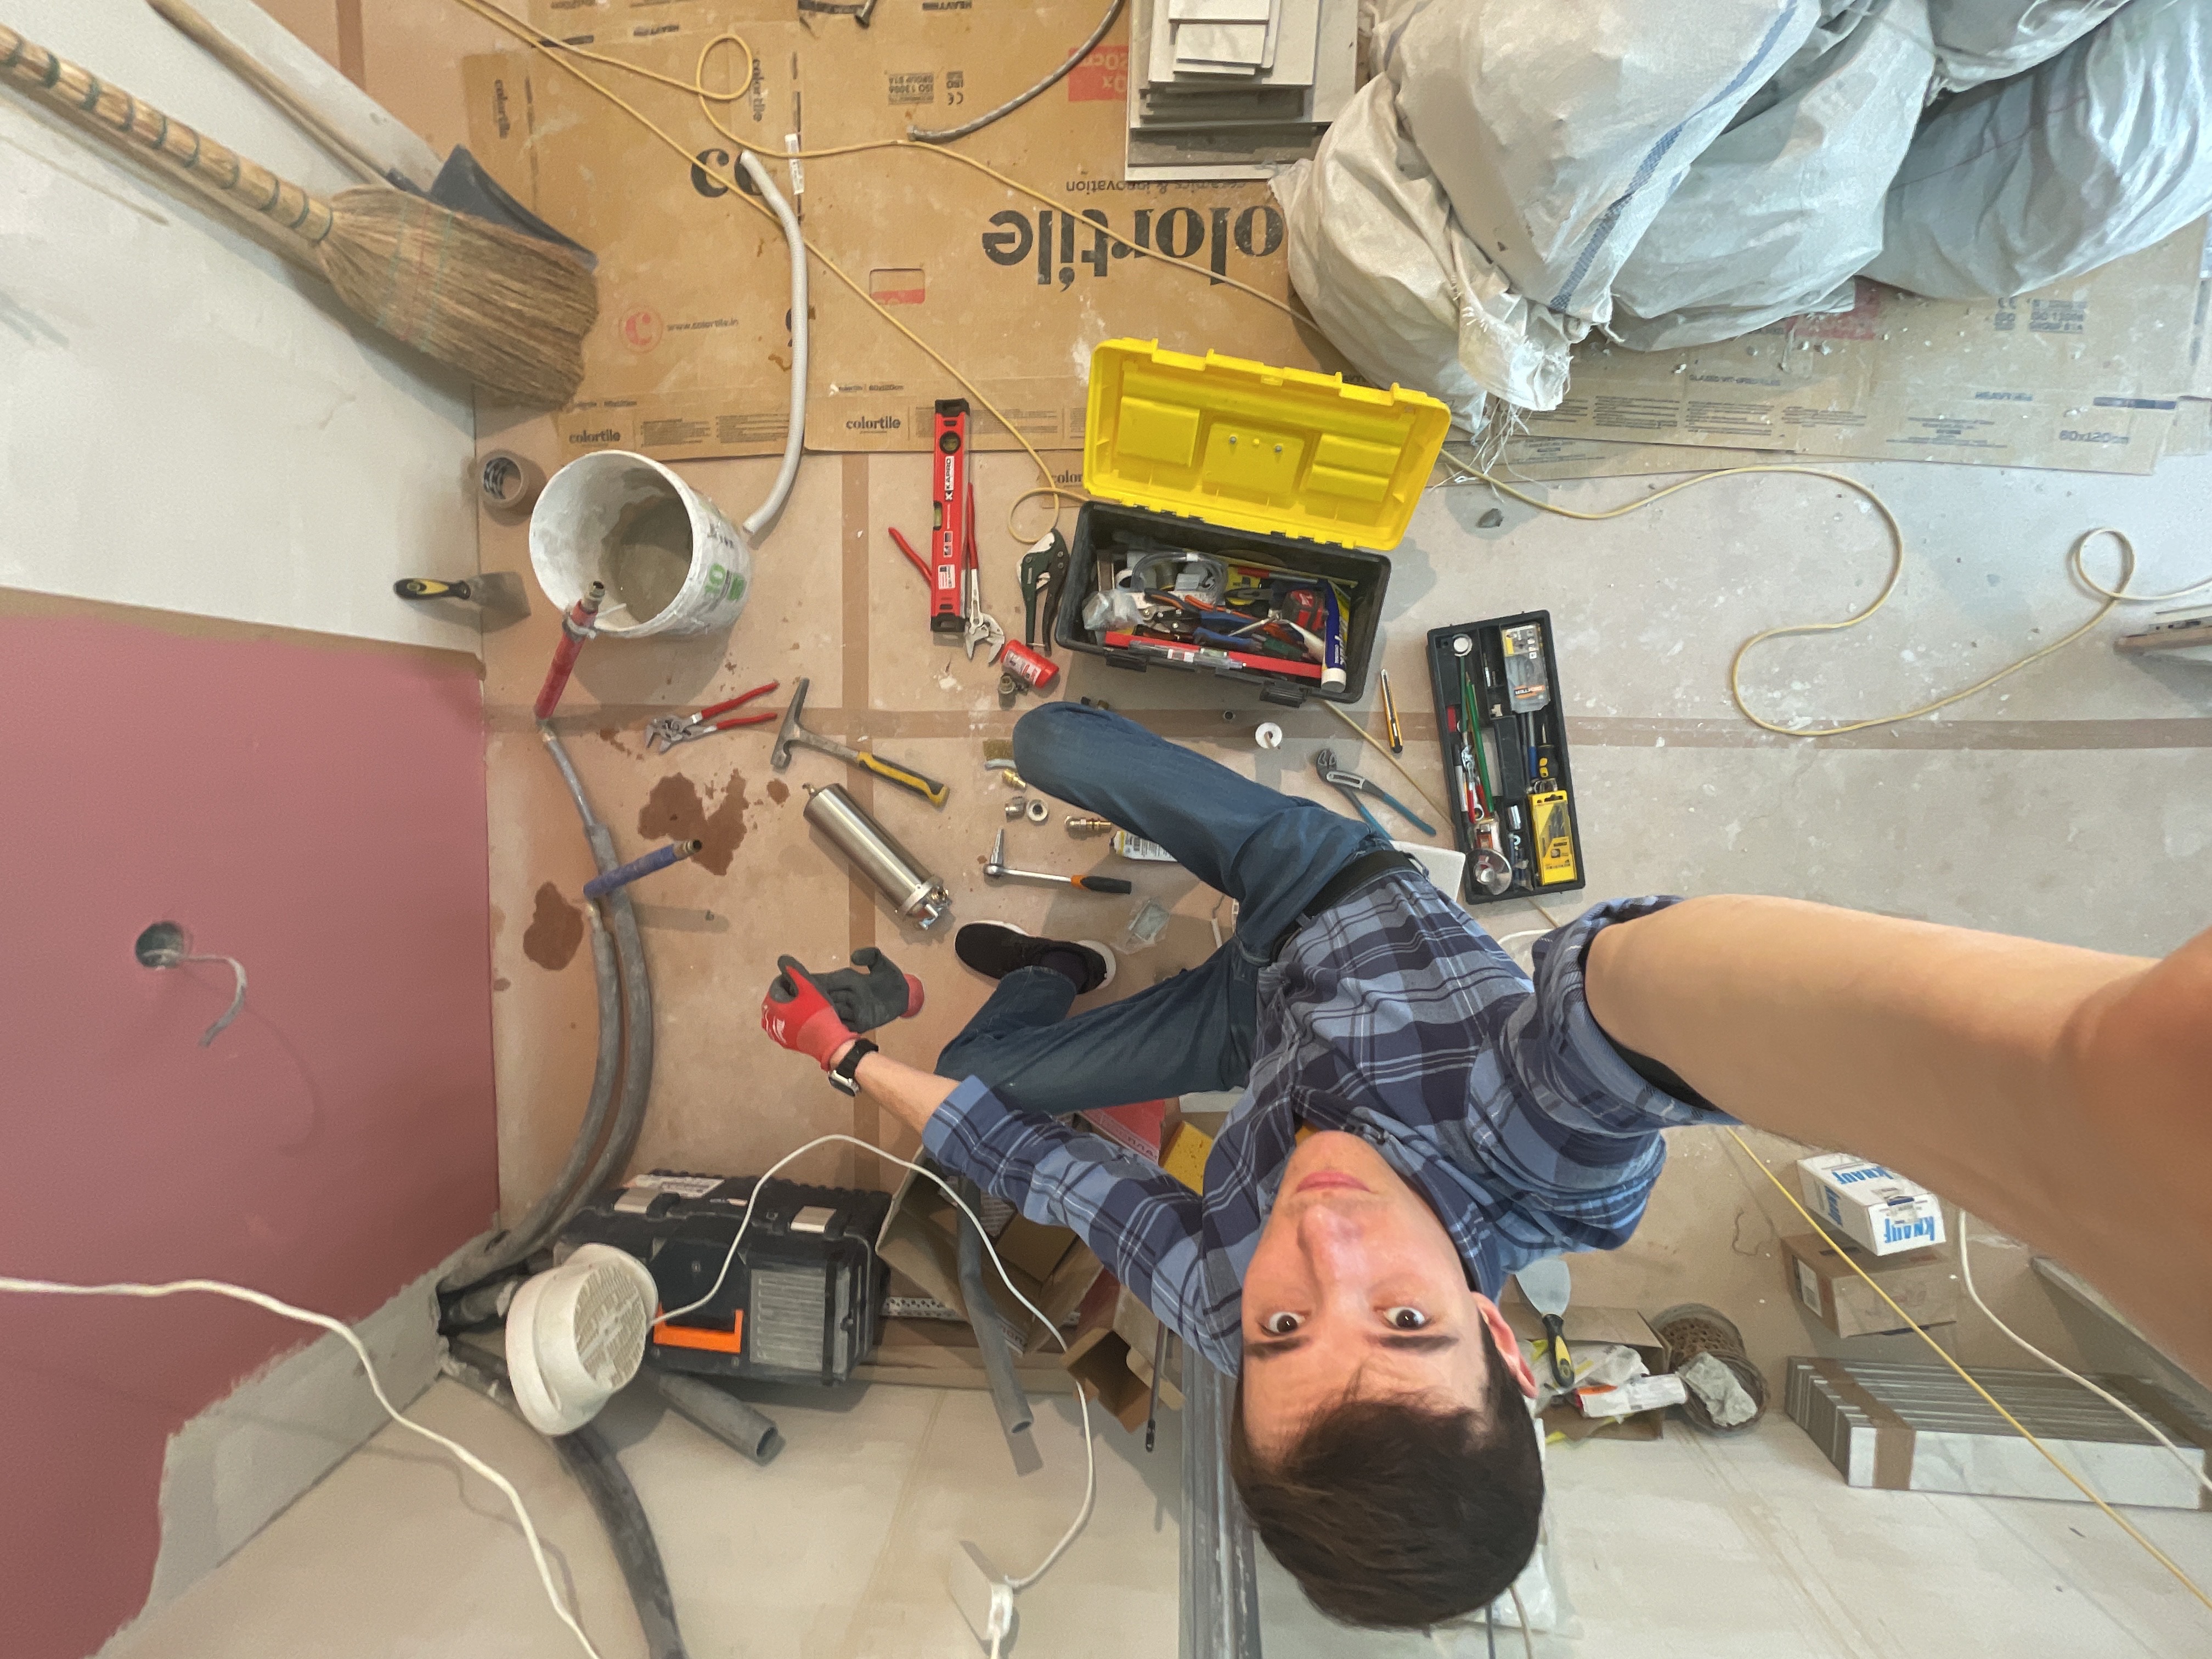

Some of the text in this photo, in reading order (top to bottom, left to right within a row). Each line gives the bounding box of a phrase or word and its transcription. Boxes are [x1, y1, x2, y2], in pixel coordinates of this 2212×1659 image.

[845, 415, 901, 431] colortile
[569, 428, 621, 444] colortile
[1051, 470, 1084, 483] olor
[1832, 1167, 1894, 1184] KNAUF
[1884, 1216, 1935, 1243] KNAUF
